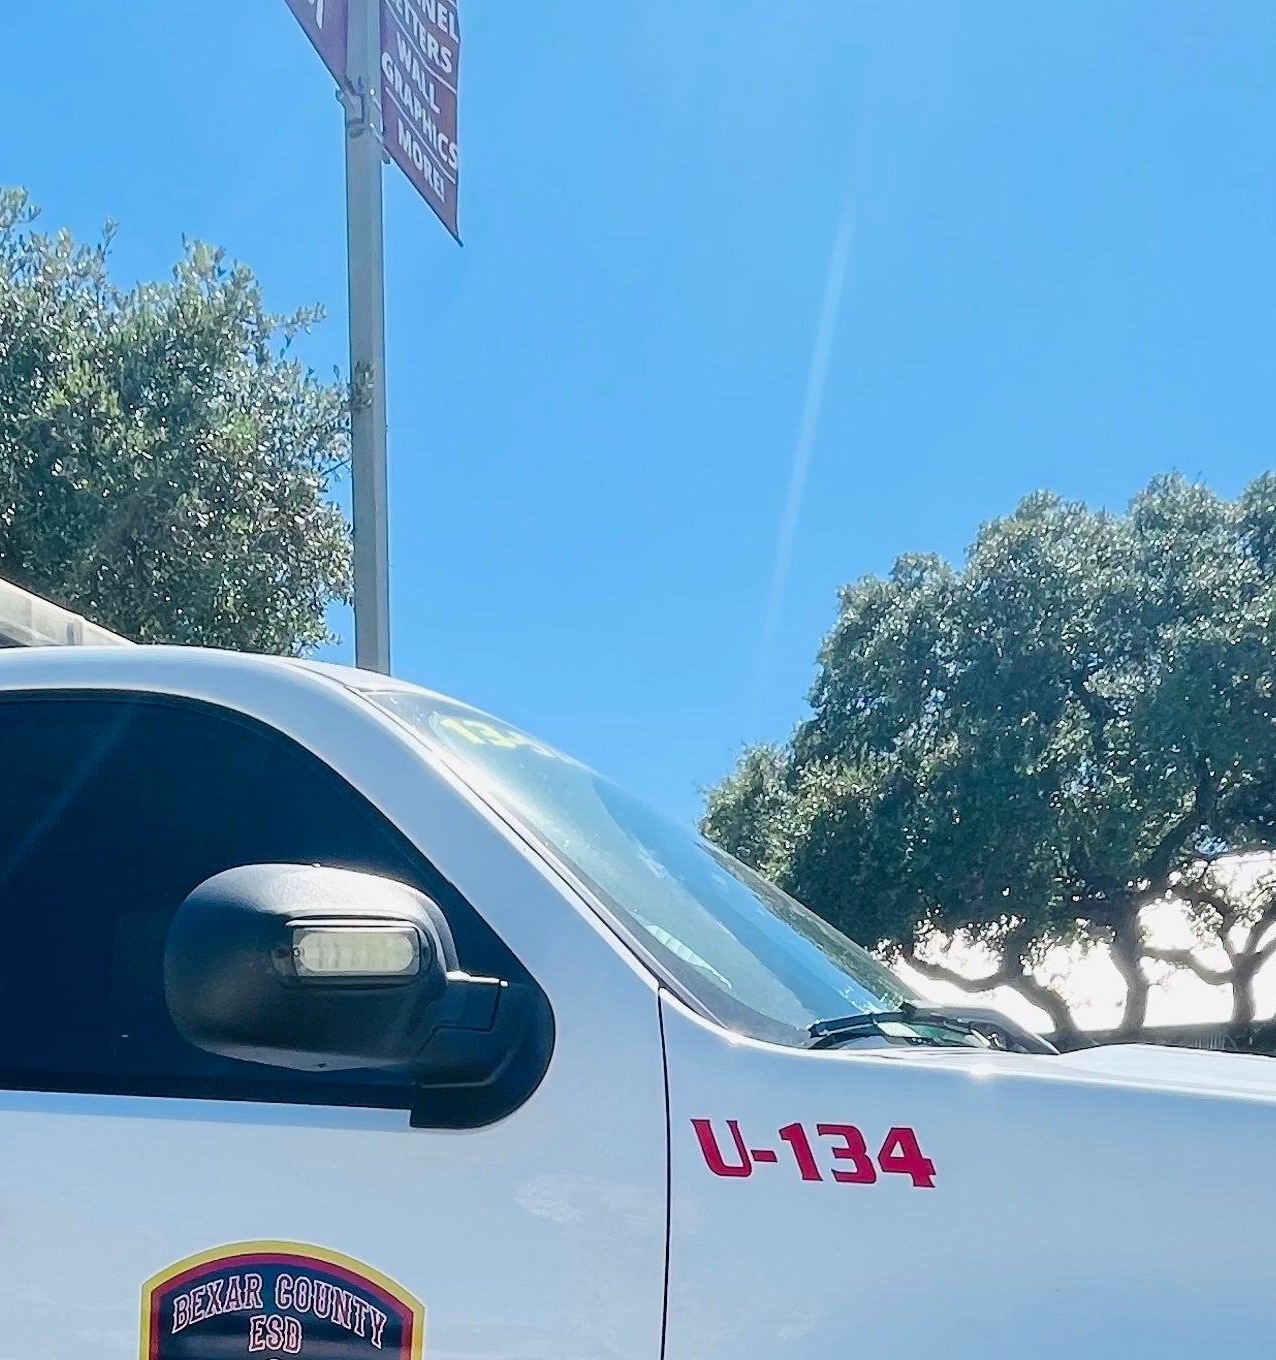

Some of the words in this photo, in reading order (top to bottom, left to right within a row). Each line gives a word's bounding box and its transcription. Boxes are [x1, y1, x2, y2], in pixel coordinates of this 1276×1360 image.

[381, 51, 458, 170] GRAPHICS
[396, 31, 440, 114] WALL
[690, 1118, 937, 1188] U-134
[172, 1272, 263, 1335] BEXAR
[274, 1273, 388, 1350] COUNTY
[248, 1314, 302, 1354] ESD
